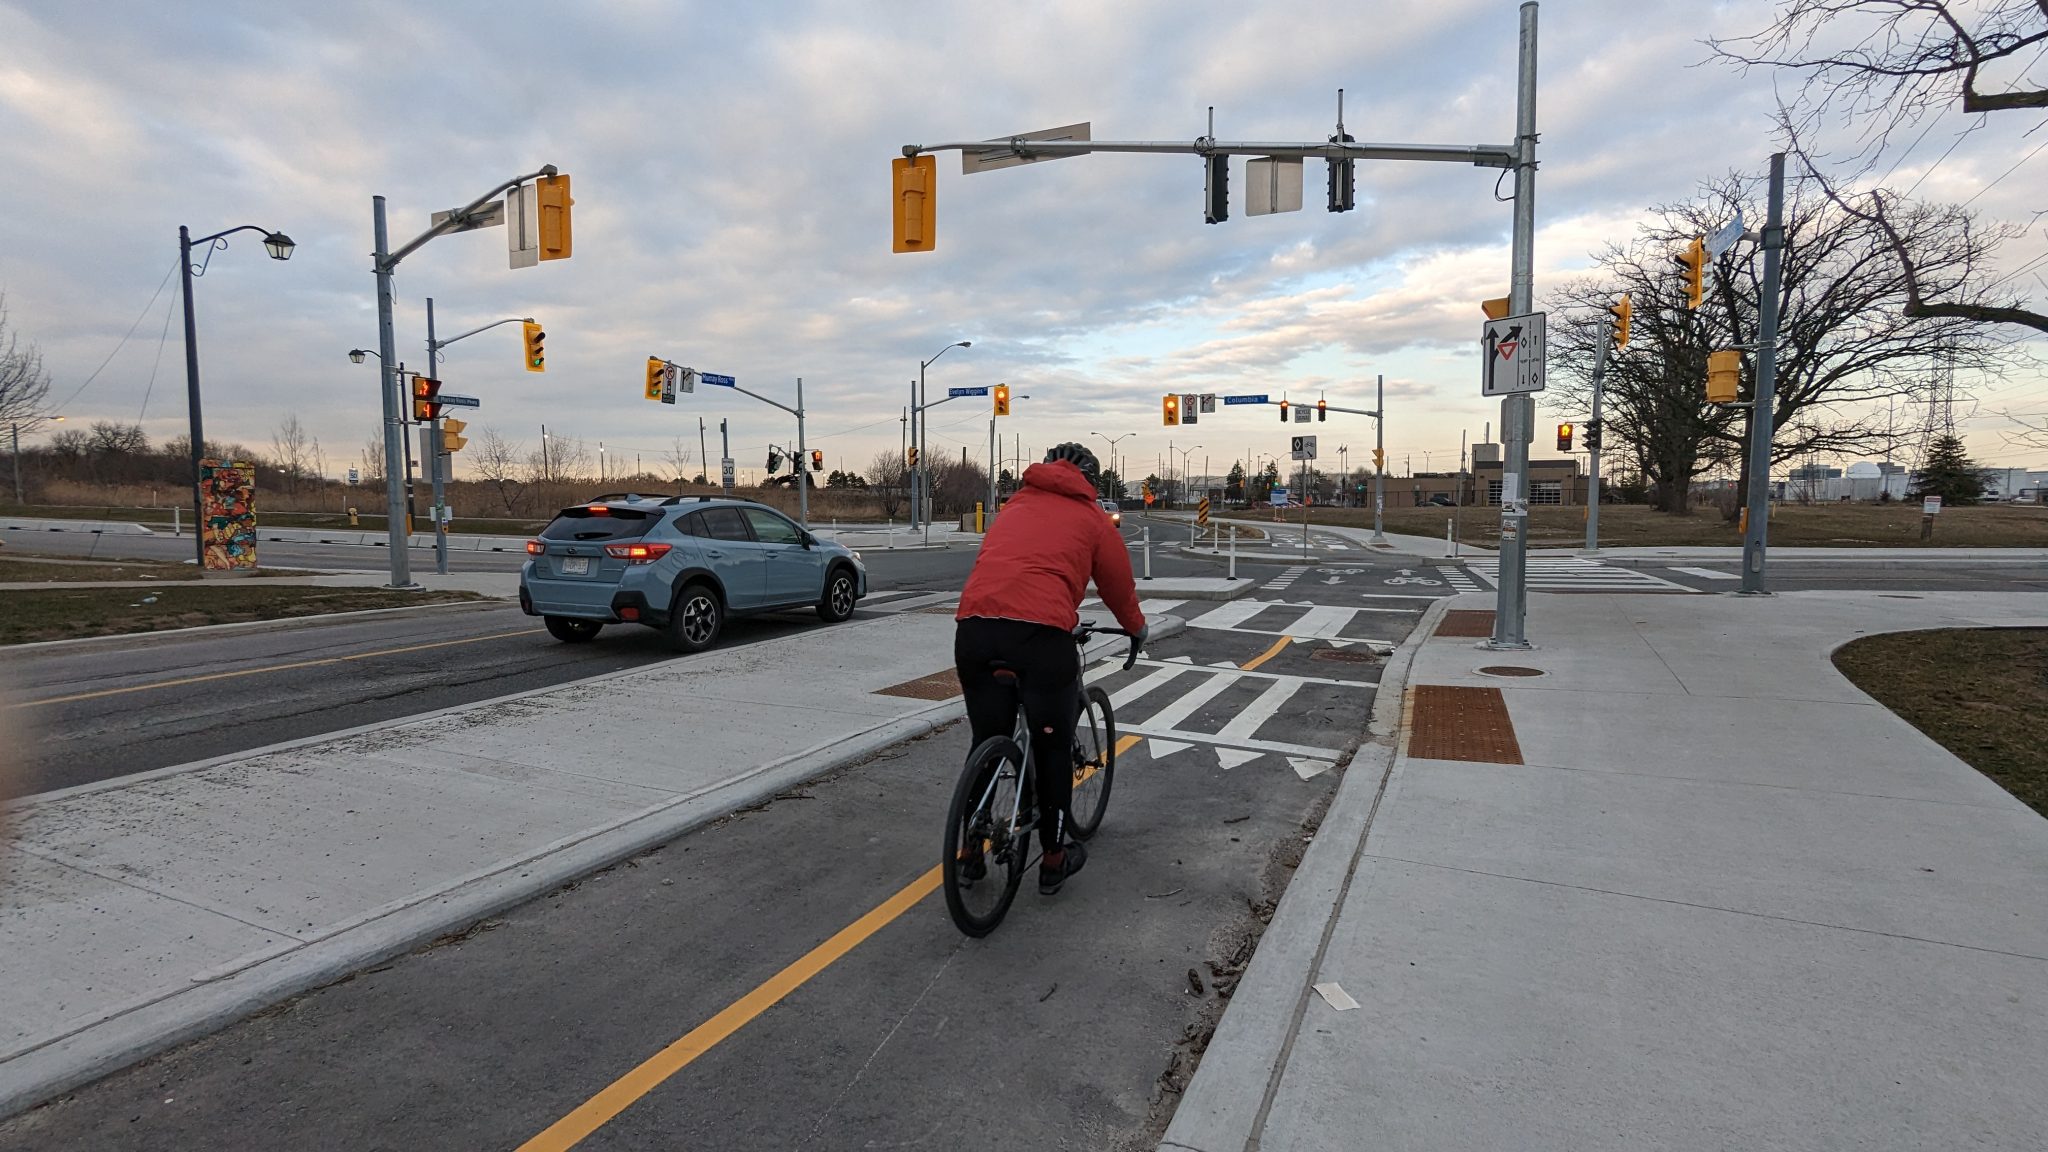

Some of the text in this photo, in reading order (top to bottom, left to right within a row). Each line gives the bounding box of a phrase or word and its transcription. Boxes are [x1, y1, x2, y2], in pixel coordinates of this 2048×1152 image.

[702, 373, 718, 384] Murray
[718, 376, 729, 384] Ross
[1227, 396, 1259, 404] Columbia
[423, 403, 430, 418] 4
[723, 466, 734, 475] 30
